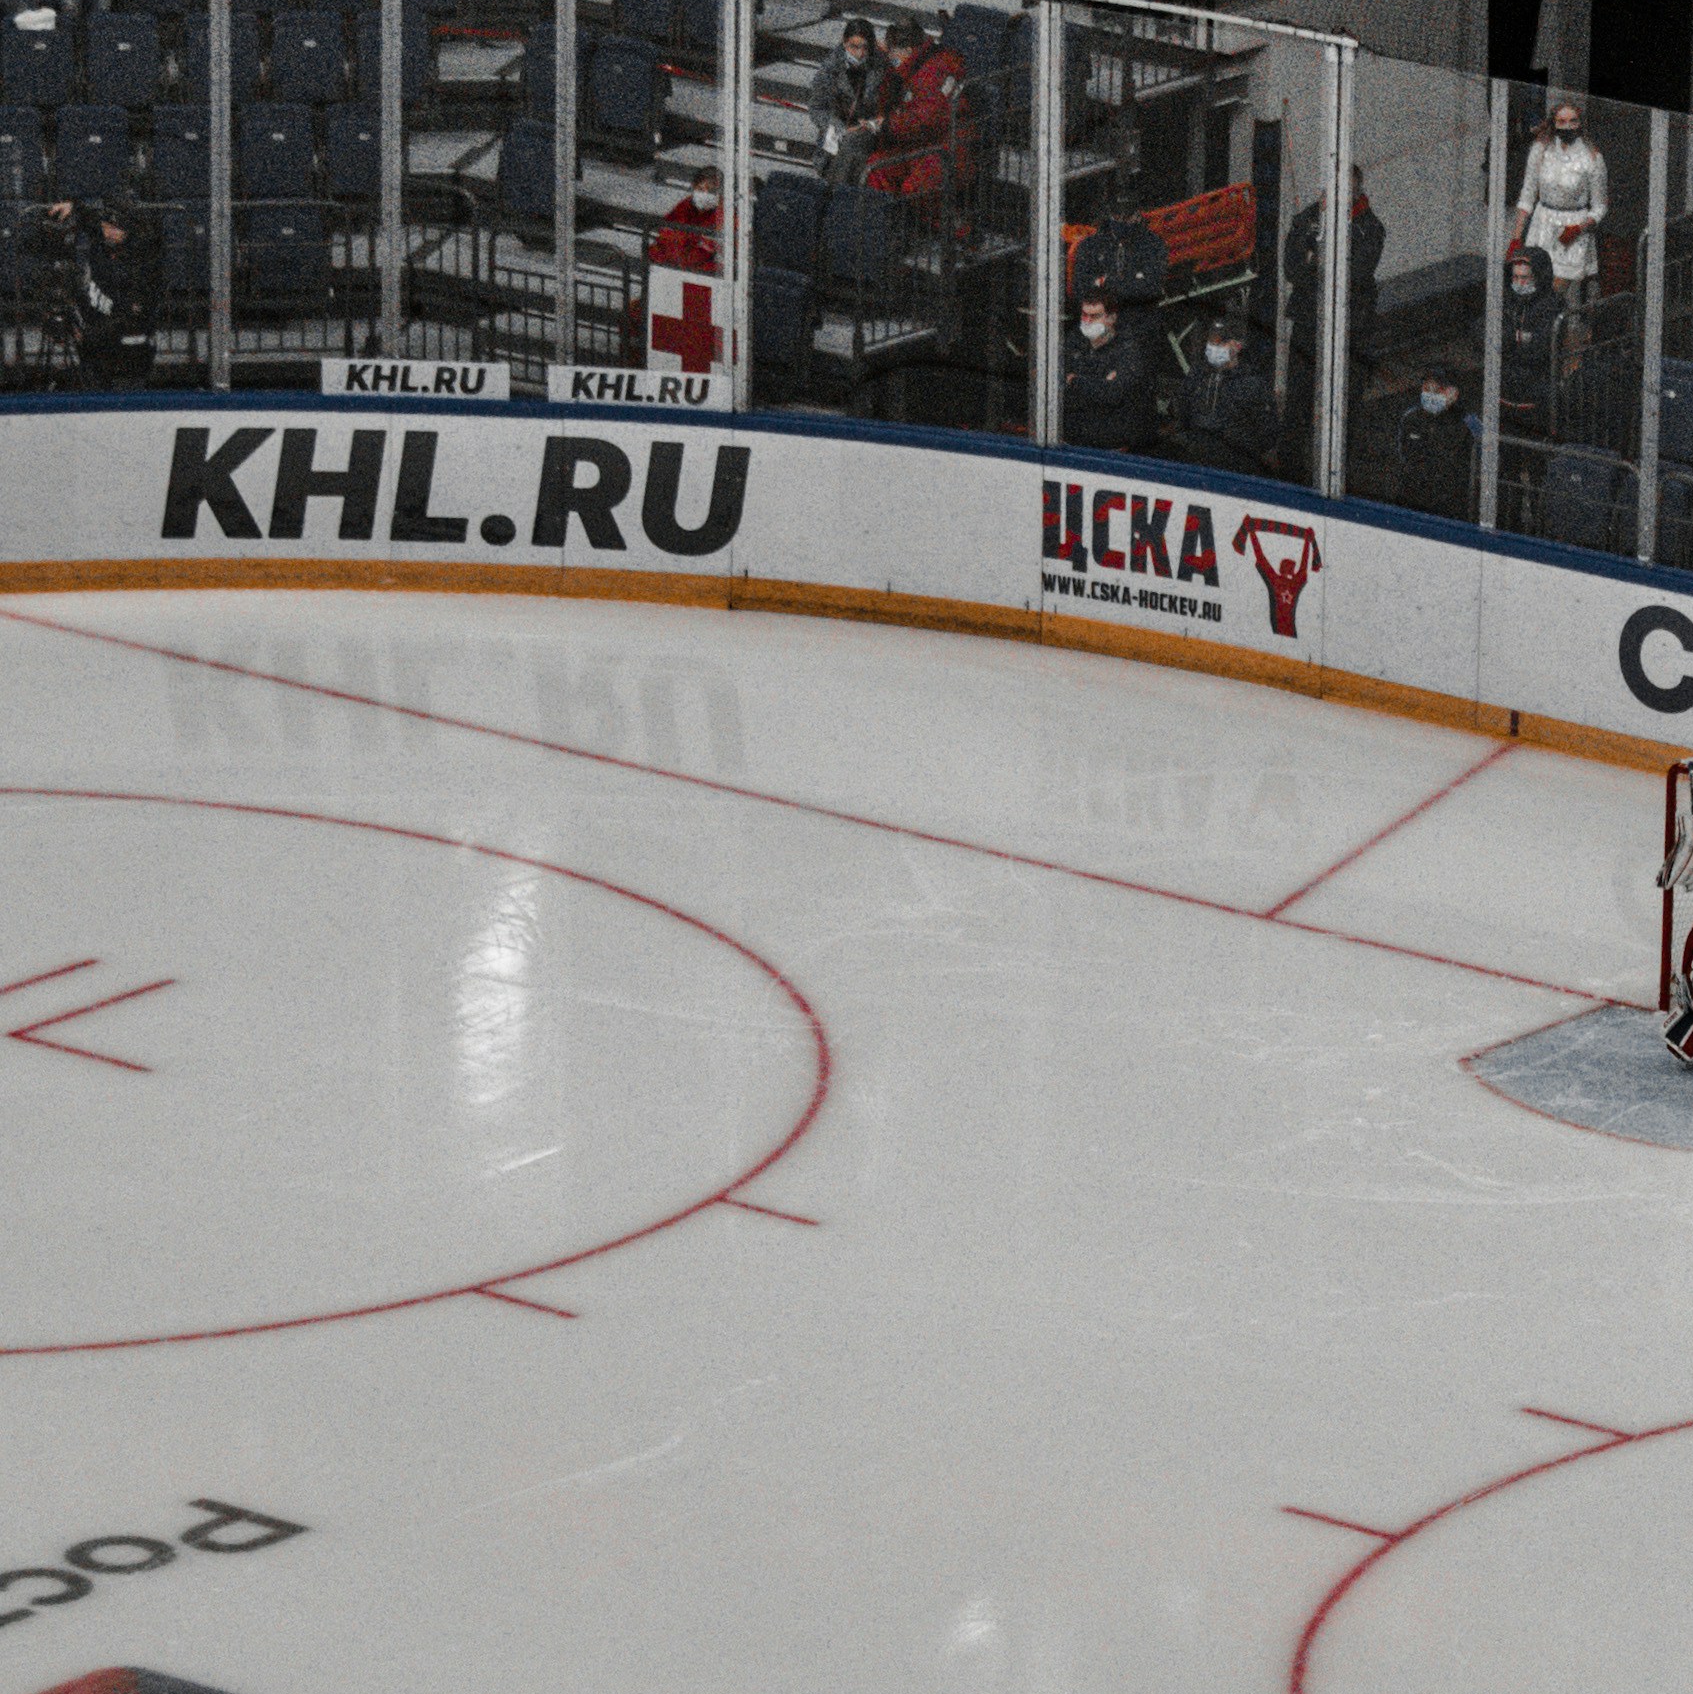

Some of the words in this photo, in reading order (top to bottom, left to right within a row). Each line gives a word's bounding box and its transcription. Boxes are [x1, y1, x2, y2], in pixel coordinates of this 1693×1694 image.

[345, 363, 487, 395] KHL.RU
[572, 371, 711, 405] KHL.RU
[161, 425, 752, 557] KHL.RU
[1042, 479, 1220, 588] ЦСКА
[1042, 571, 1222, 623] WWW.CSKA-HOCKEY.RU
